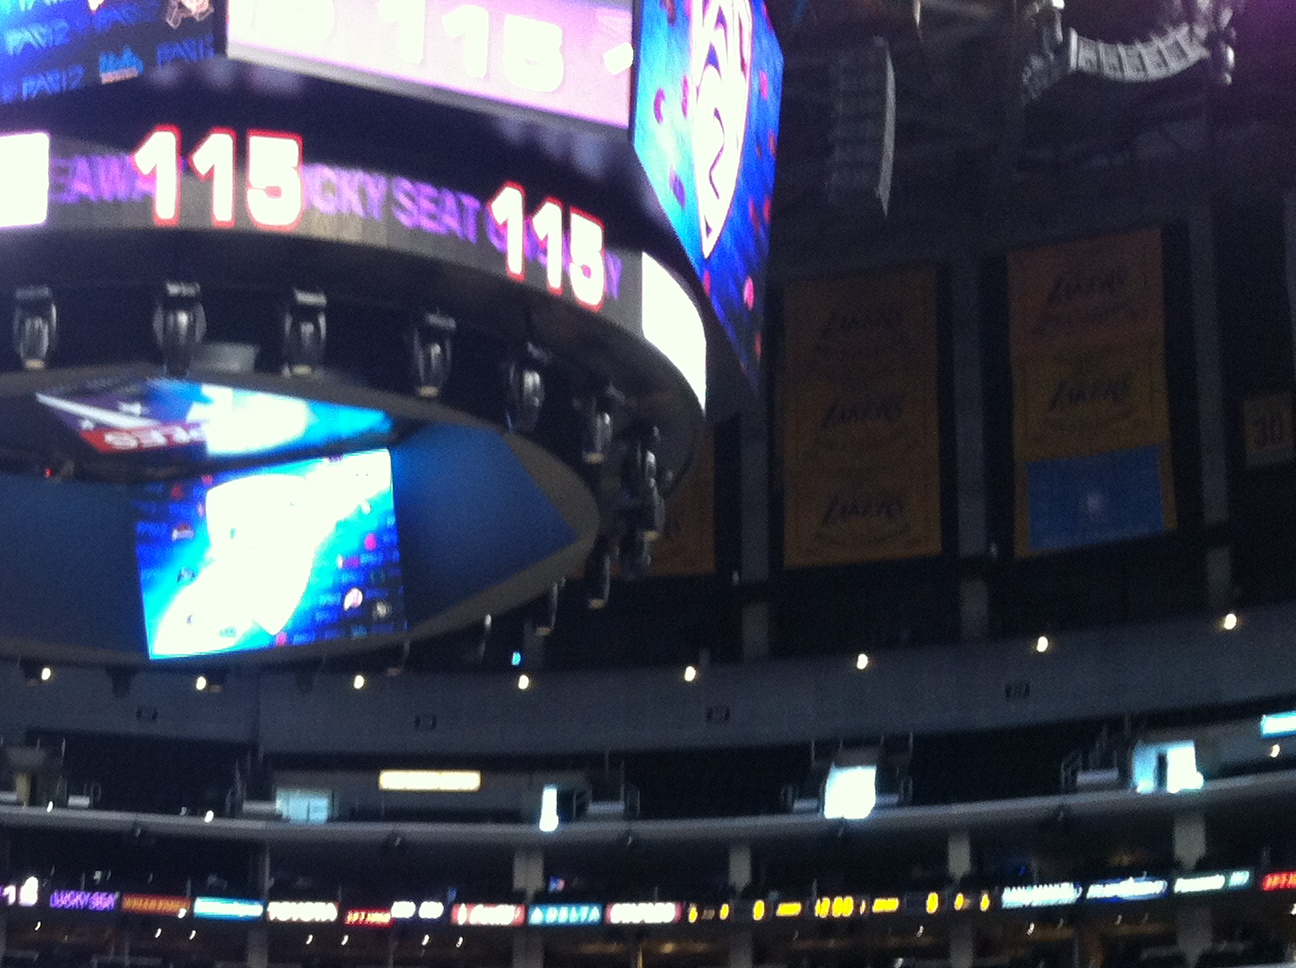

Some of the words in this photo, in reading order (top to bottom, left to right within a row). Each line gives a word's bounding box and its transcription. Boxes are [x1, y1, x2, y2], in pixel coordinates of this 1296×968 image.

[128, 124, 304, 231] 115
[391, 176, 480, 245] SEAT
[488, 181, 605, 312] 115
